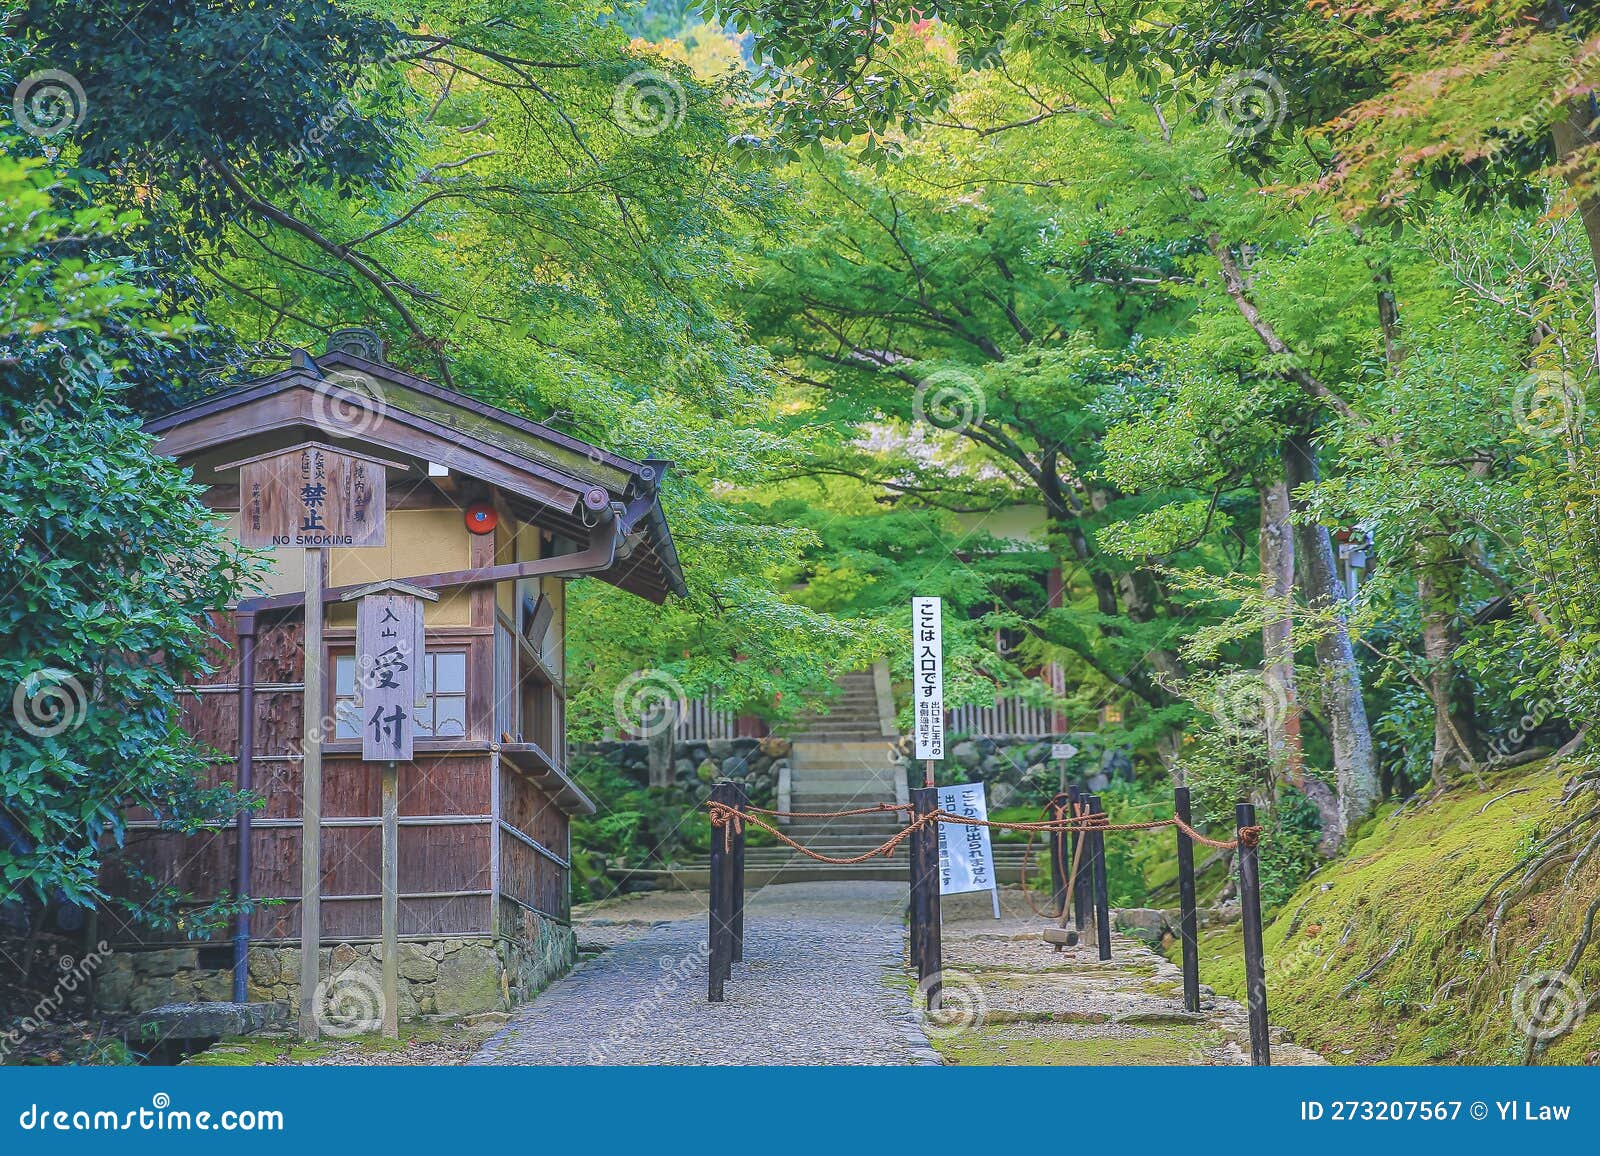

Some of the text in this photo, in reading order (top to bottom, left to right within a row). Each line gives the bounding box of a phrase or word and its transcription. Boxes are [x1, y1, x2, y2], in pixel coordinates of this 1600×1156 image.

[314, 450, 326, 480] たき火
[300, 482, 327, 531] 禁止
[272, 535, 353, 545] NO SMOKING
[962, 790, 987, 885] ここかは出られません
